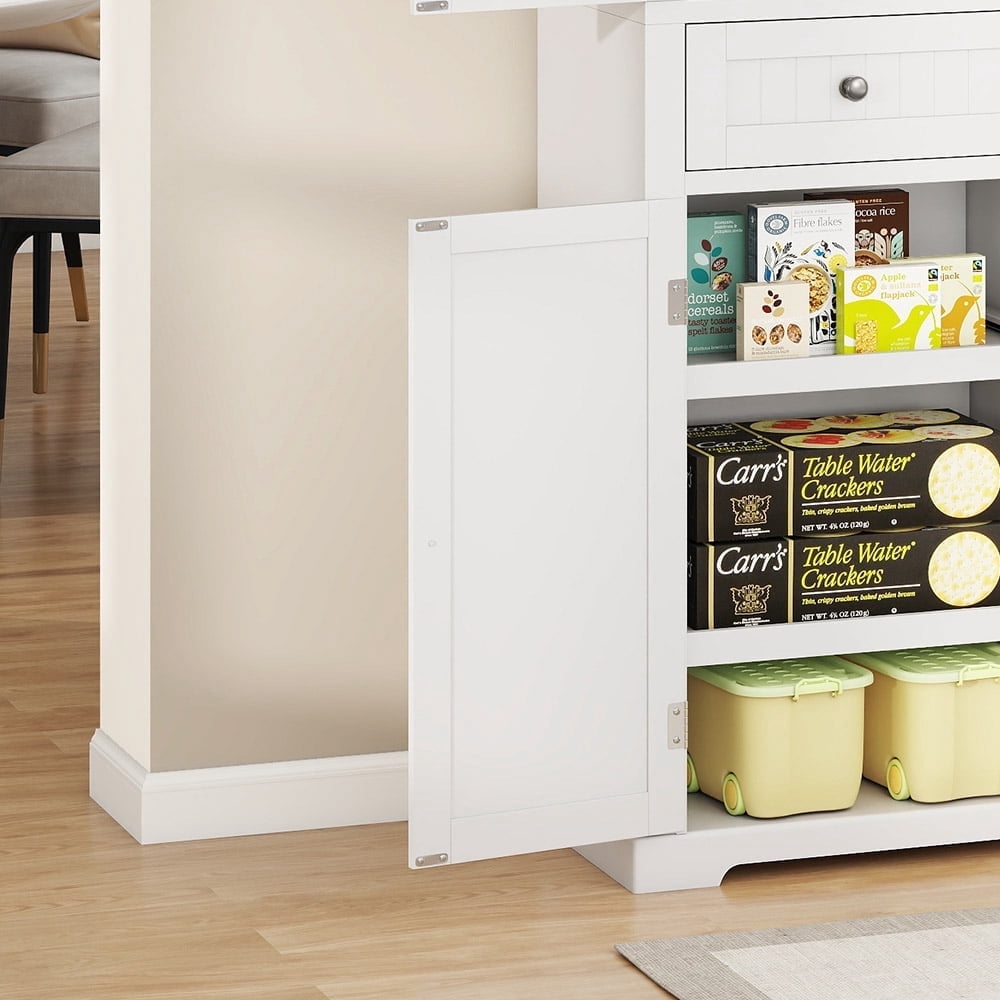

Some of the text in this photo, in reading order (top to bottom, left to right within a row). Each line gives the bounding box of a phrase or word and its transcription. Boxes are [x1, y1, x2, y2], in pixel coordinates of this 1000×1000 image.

[855, 206, 896, 218] ocoa rice
[793, 217, 816, 228] Fibre
[817, 215, 843, 226] flakes
[881, 273, 906, 282] Apple
[941, 272, 960, 281] jack
[890, 281, 921, 289] sultana
[687, 291, 729, 304] dorset
[880, 290, 915, 301] flapjack
[687, 304, 734, 316] cereals
[687, 317, 737, 327] tasty toaste
[687, 326, 734, 336] spelt flakes
[716, 454, 787, 485] Carr's
[802, 453, 911, 478] Table Water
[801, 475, 884, 500] Crackers
[817, 507, 834, 516] crispy
[878, 503, 897, 512] golden
[801, 524, 814, 532] NET
[839, 521, 849, 529] OZ
[716, 543, 787, 574] Carr's
[802, 542, 911, 567] Table Water
[801, 565, 884, 589] Crackers
[817, 596, 834, 605] crispy
[878, 592, 897, 601] golden
[801, 613, 814, 621] NET
[839, 610, 849, 618] OZ
